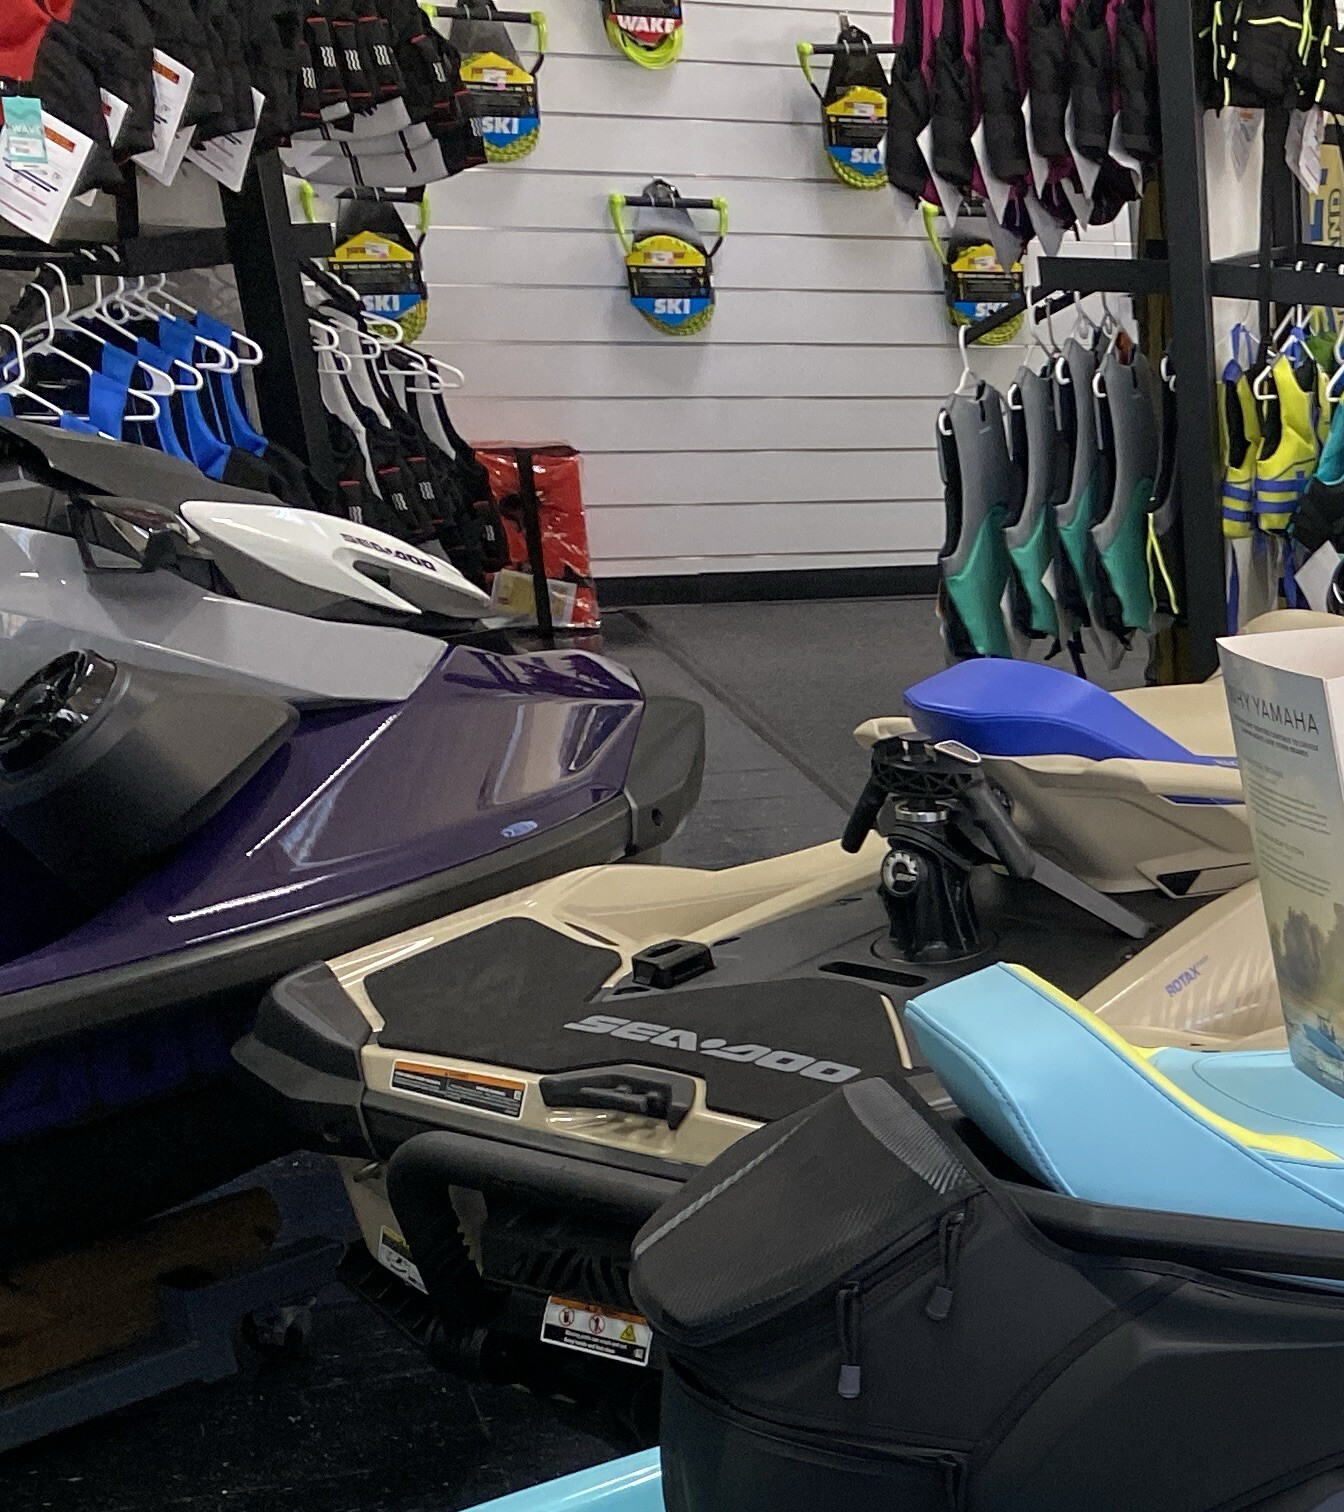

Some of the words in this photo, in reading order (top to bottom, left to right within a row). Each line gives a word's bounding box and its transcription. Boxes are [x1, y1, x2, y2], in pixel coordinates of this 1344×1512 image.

[616, 15, 676, 34] WAKE
[480, 117, 520, 135] SKI
[653, 298, 691, 315] SKI
[1250, 694, 1320, 737] YAMAHA
